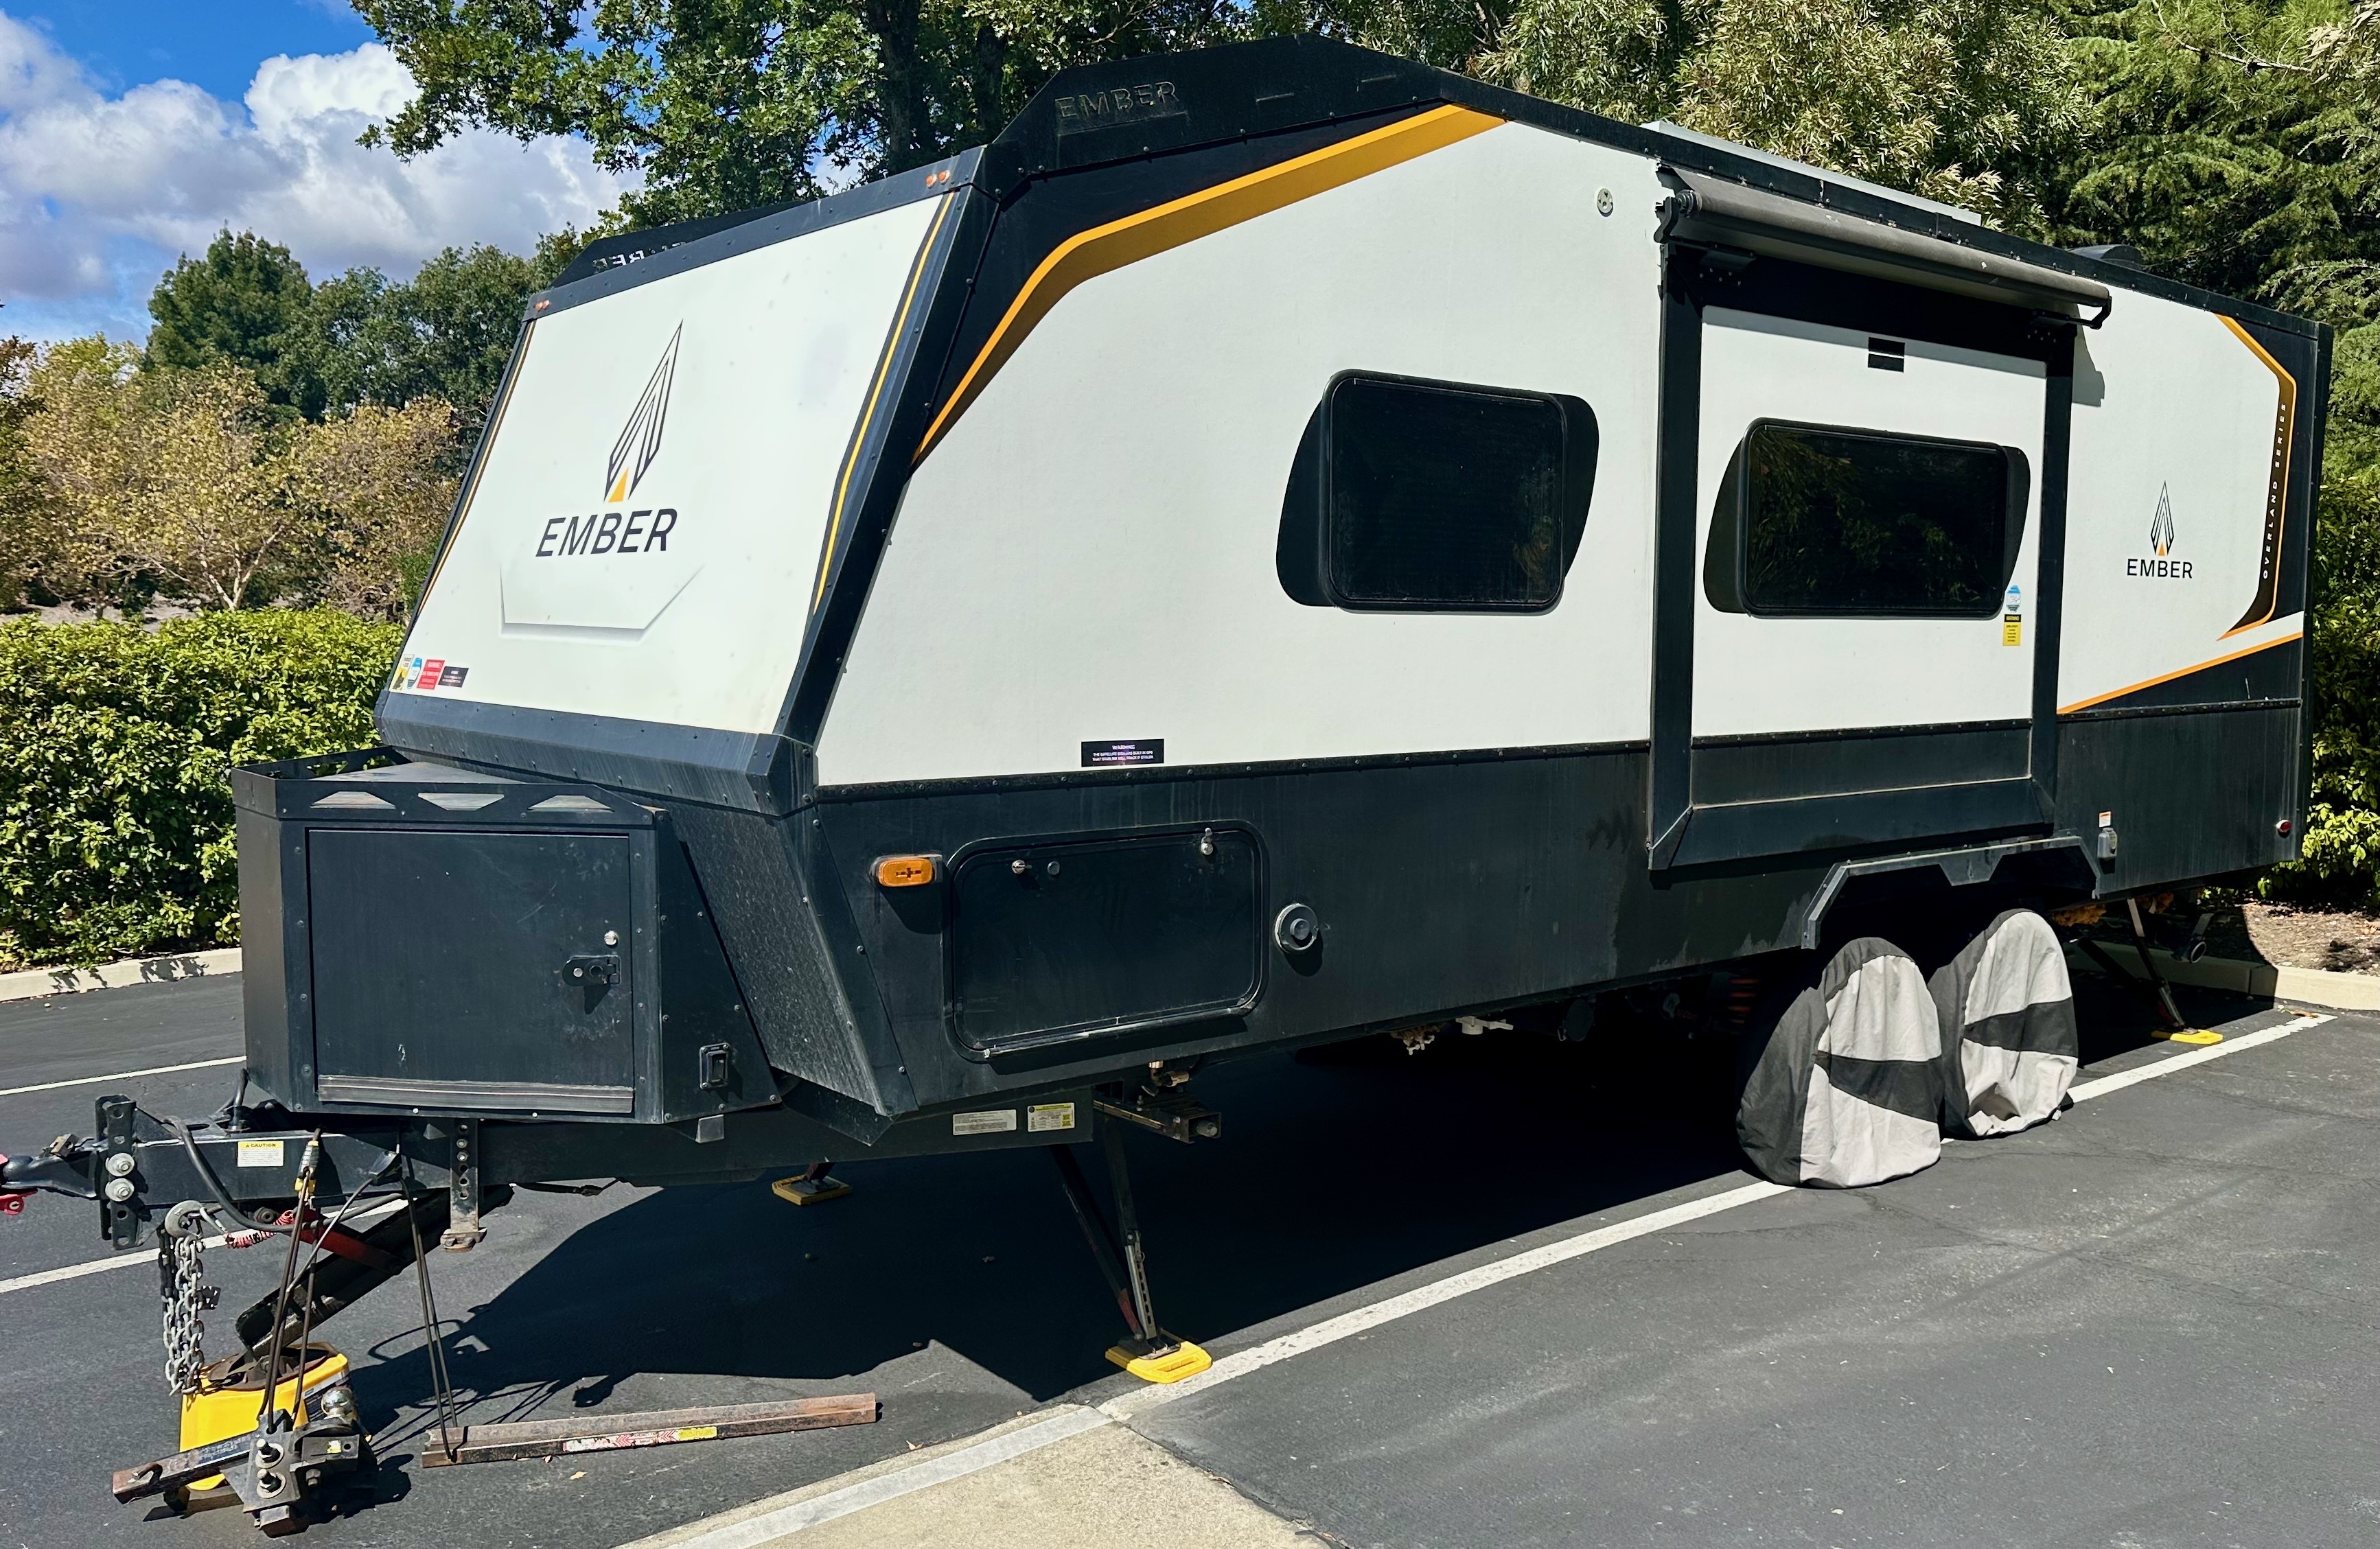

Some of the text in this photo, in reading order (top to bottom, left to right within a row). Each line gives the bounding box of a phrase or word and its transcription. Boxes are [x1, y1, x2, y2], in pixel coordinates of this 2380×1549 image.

[1054, 80, 1179, 119] EMBER
[2263, 404, 2286, 579] OVERLAND SERIES
[535, 508, 678, 557] EMBER
[2127, 558, 2193, 579] EMBER
